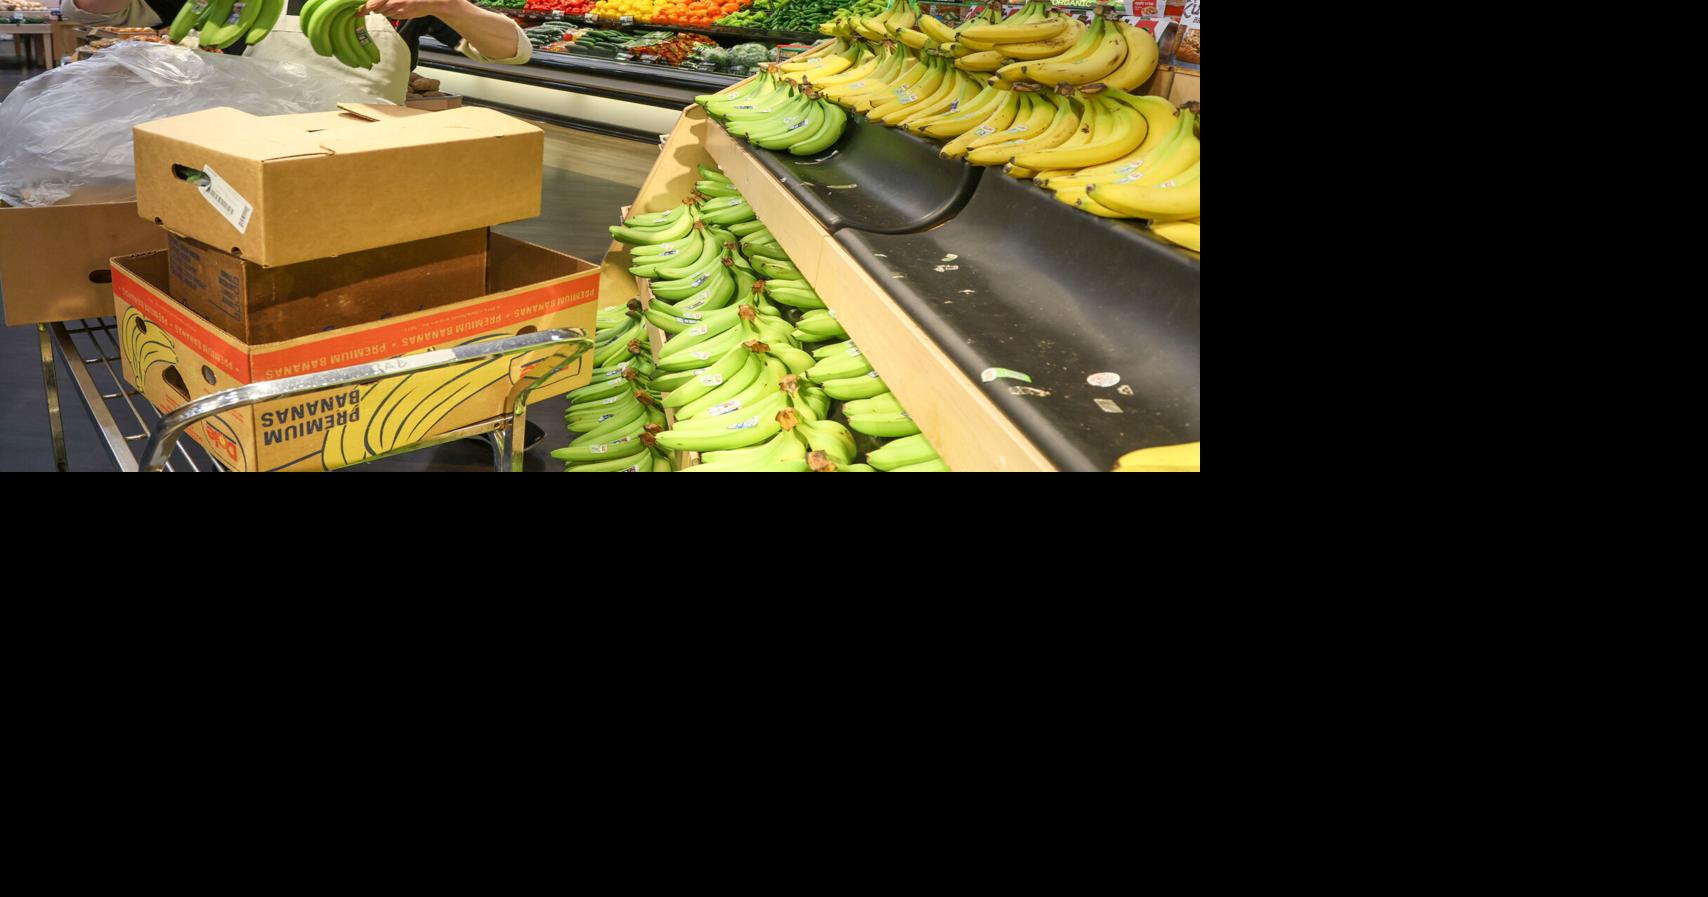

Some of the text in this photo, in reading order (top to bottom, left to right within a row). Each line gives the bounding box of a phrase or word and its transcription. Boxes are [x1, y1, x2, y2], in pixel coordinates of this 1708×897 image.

[556, 288, 595, 305] PREMIUM
[513, 298, 557, 318] BANANAS
[454, 314, 502, 333] PREMIUM
[401, 324, 452, 346] BANANAS
[330, 343, 386, 361] PREMIUM
[265, 356, 328, 379] BANANAS
[261, 388, 360, 428] BANANAS
[263, 406, 360, 446] PREMIUM
[205, 425, 239, 463] Dole
